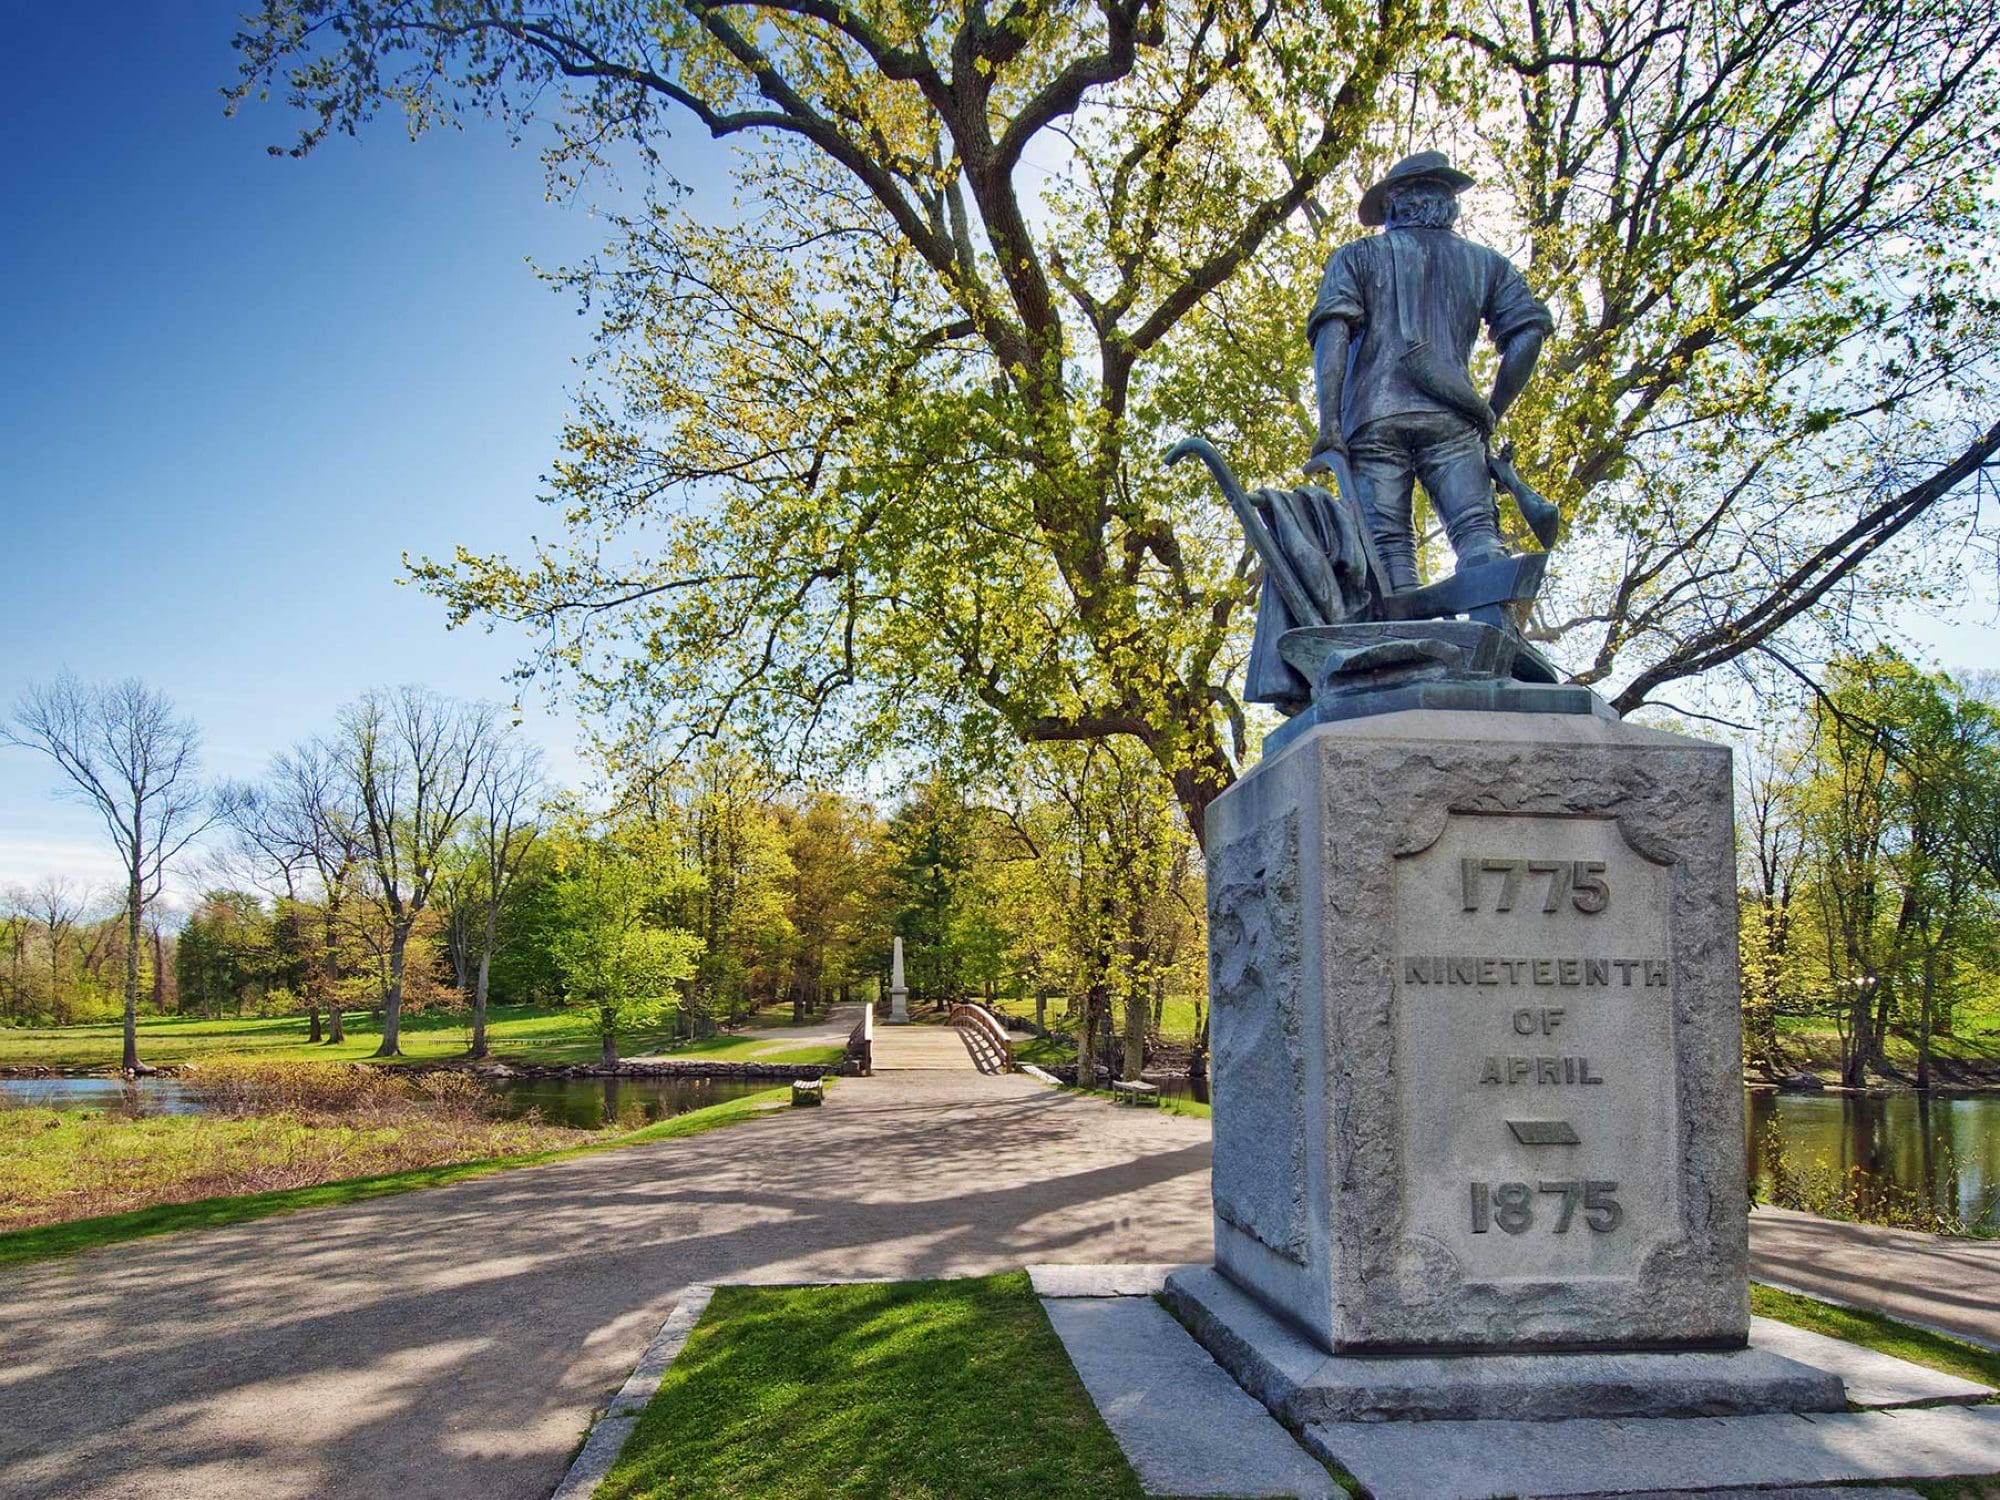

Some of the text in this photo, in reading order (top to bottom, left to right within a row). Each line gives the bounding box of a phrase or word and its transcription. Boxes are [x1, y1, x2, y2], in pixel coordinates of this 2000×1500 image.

[1461, 858, 1611, 915] 1775
[1404, 956, 1669, 987] NINETEENTH
[1512, 1005, 1567, 1036] OF
[1478, 1055, 1604, 1085] APRIL
[1469, 1181, 1623, 1235] 1875
